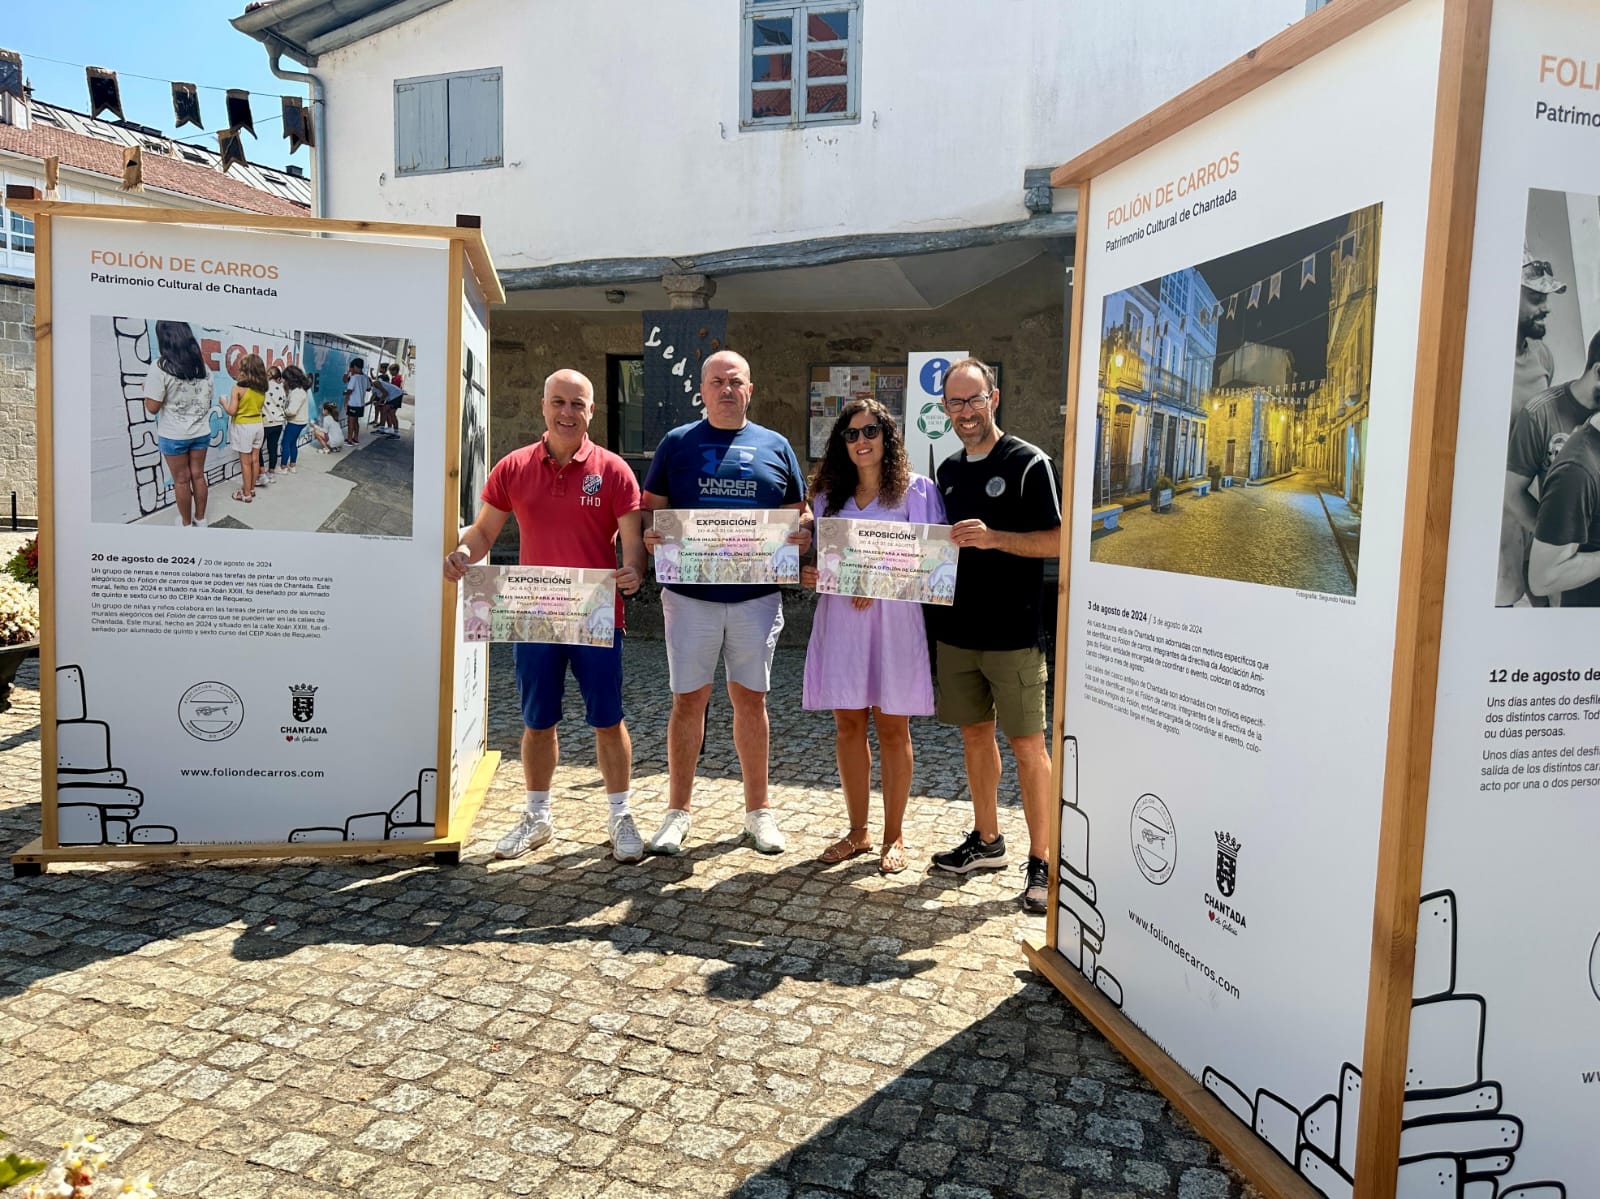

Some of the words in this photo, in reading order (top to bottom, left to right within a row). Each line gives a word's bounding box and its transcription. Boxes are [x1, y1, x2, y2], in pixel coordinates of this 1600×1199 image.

[1107, 192, 1151, 229] FOLIÓN
[1155, 181, 1174, 208] DE
[1177, 151, 1239, 197] CARROS
[1106, 227, 1144, 251] Patrimonio
[1146, 211, 1177, 235] Cultural
[1179, 208, 1190, 222] de
[1192, 189, 1236, 216] Chantada
[91, 250, 162, 269] FOLIÓN
[170, 257, 195, 272] DE
[200, 260, 278, 279] CARROS
[91, 272, 153, 286] Patrimonio
[157, 278, 202, 290] Cultural
[205, 282, 220, 292] de
[223, 284, 277, 296] Chantada
[698, 477, 757, 489] UNDER
[700, 488, 756, 498] ARMOUR
[580, 496, 601, 507] THD
[696, 518, 757, 526] EXPOSICIÓNS
[858, 530, 916, 540] EXPOSICIÓNS
[91, 553, 104, 561] 20
[171, 556, 195, 564] 2024
[508, 576, 572, 584] EXPOSICIÓNS
[1319, 594, 1338, 602] Segundo
[1088, 600, 1091, 609] 3
[1092, 602, 1099, 611] de
[1100, 606, 1120, 616] agosto
[1122, 608, 1129, 618] de
[1131, 609, 1146, 621] 2024
[1164, 621, 1179, 629] agosto
[1189, 624, 1201, 633] 2024
[1210, 675, 1231, 686] colocan
[1232, 681, 1239, 689] os
[1489, 669, 1507, 682] 12
[1511, 669, 1528, 682] de
[1533, 668, 1580, 684] agosto
[1584, 668, 1600, 682] de
[1487, 697, 1505, 707] Uns
[1530, 696, 1555, 706] antes
[1558, 696, 1570, 705] do
[1486, 713, 1503, 722] dos
[1505, 711, 1545, 722] distintos
[1547, 712, 1579, 721] carros.
[280, 726, 328, 735] CHANTADA
[1484, 730, 1496, 738] ou
[1499, 727, 1522, 737] dúas
[1525, 728, 1565, 739] persoas.
[1483, 750, 1507, 760] Unos
[1531, 748, 1557, 758] antes
[1559, 747, 1574, 757] del
[181, 768, 324, 778] www.foliondecarros.com
[1481, 765, 1509, 775] salida
[1511, 764, 1524, 774] de
[1526, 763, 1540, 773] los
[1542, 762, 1581, 772] distintos
[1480, 781, 1501, 791] acto
[1503, 781, 1520, 792] por
[1522, 780, 1539, 789] una
[1542, 780, 1548, 788] o
[1551, 777, 1568, 787] dos
[1204, 893, 1247, 928] CHANTADA
[1222, 920, 1238, 936] Galicia
[1128, 910, 1240, 999] www.foliondecarros.com
